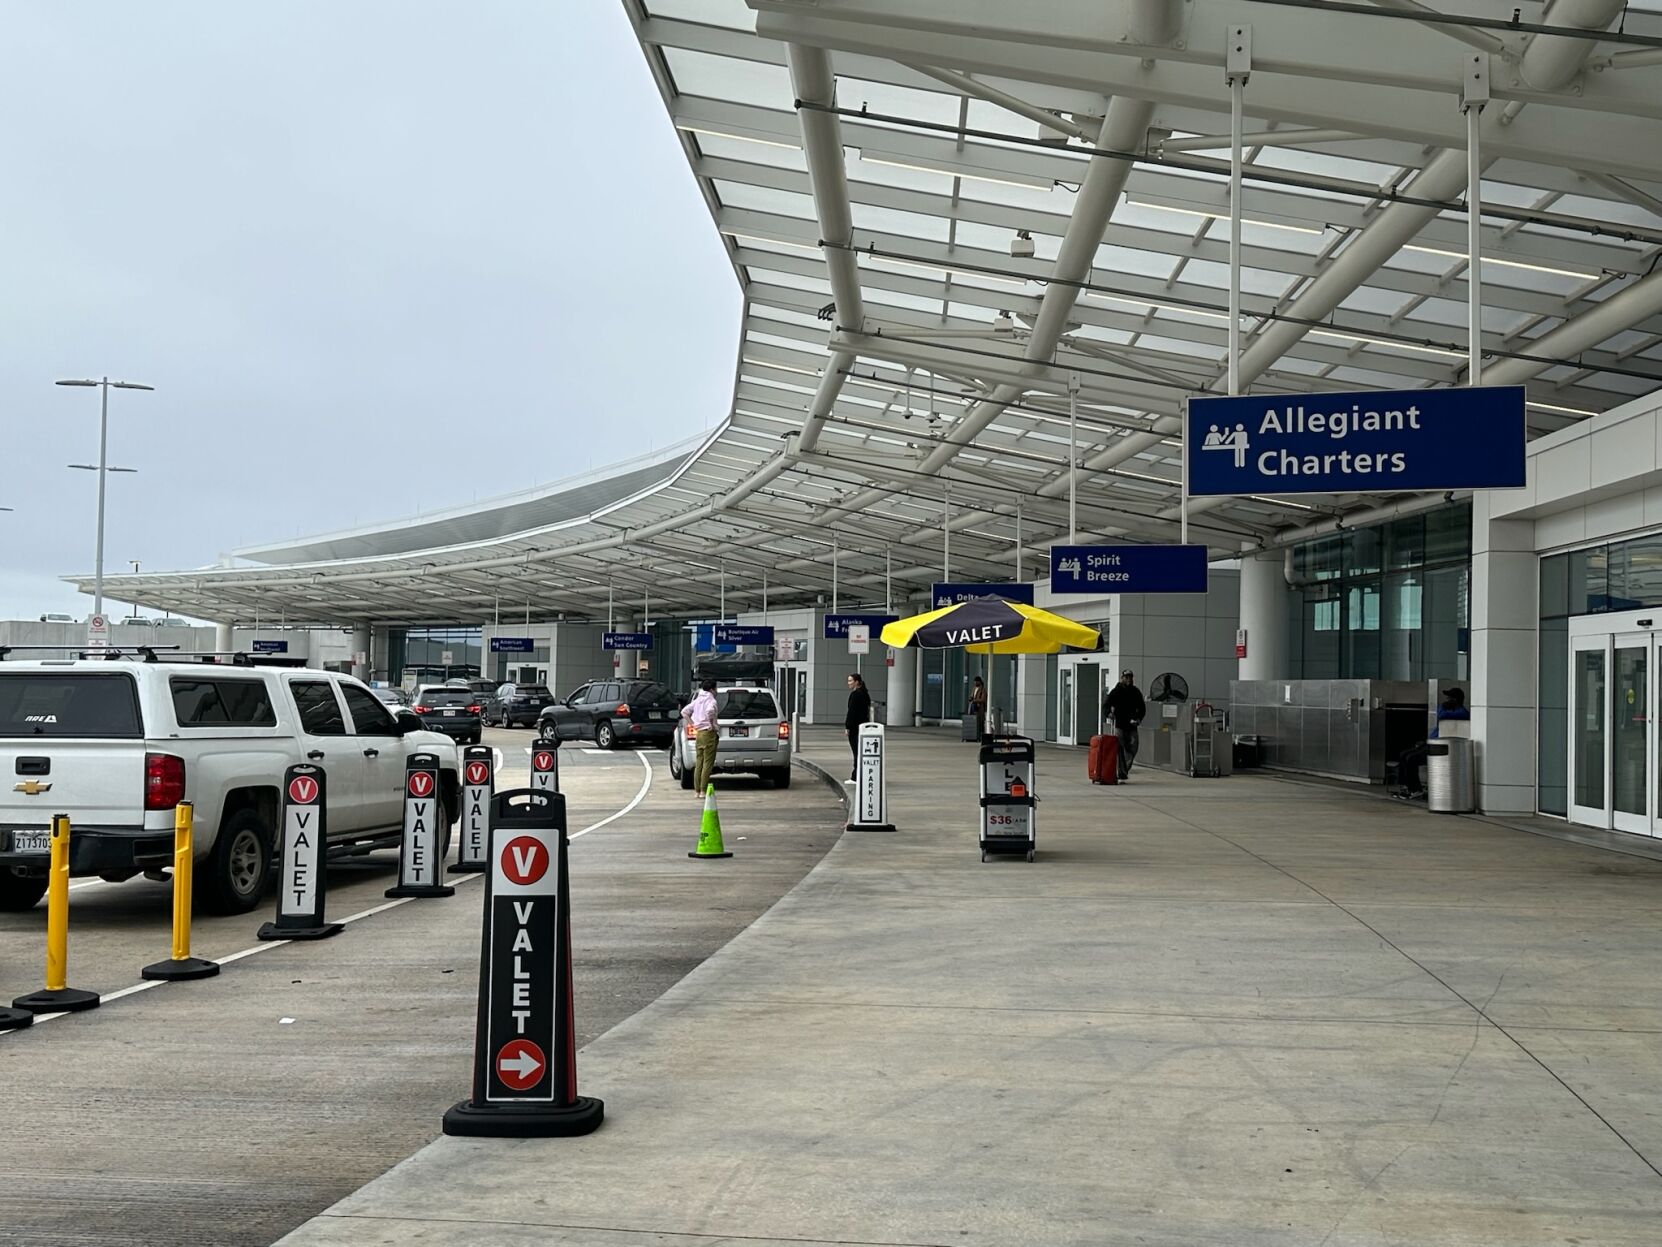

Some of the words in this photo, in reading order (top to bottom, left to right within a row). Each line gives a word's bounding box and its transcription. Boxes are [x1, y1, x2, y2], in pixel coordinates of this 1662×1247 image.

[1258, 405, 1420, 438] Allegiant
[1257, 449, 1406, 476] Charters
[1087, 554, 1121, 568] Spirit
[1087, 571, 1130, 581] Breeze
[946, 624, 1003, 644] VALET
[539, 755, 549, 768] V
[414, 776, 428, 793] V
[471, 766, 483, 781] V
[296, 780, 311, 800] V
[470, 789, 482, 859] VALET
[411, 802, 427, 882] VALET
[293, 812, 311, 907] VALET
[511, 846, 537, 878] V
[511, 901, 534, 1034] VALET
